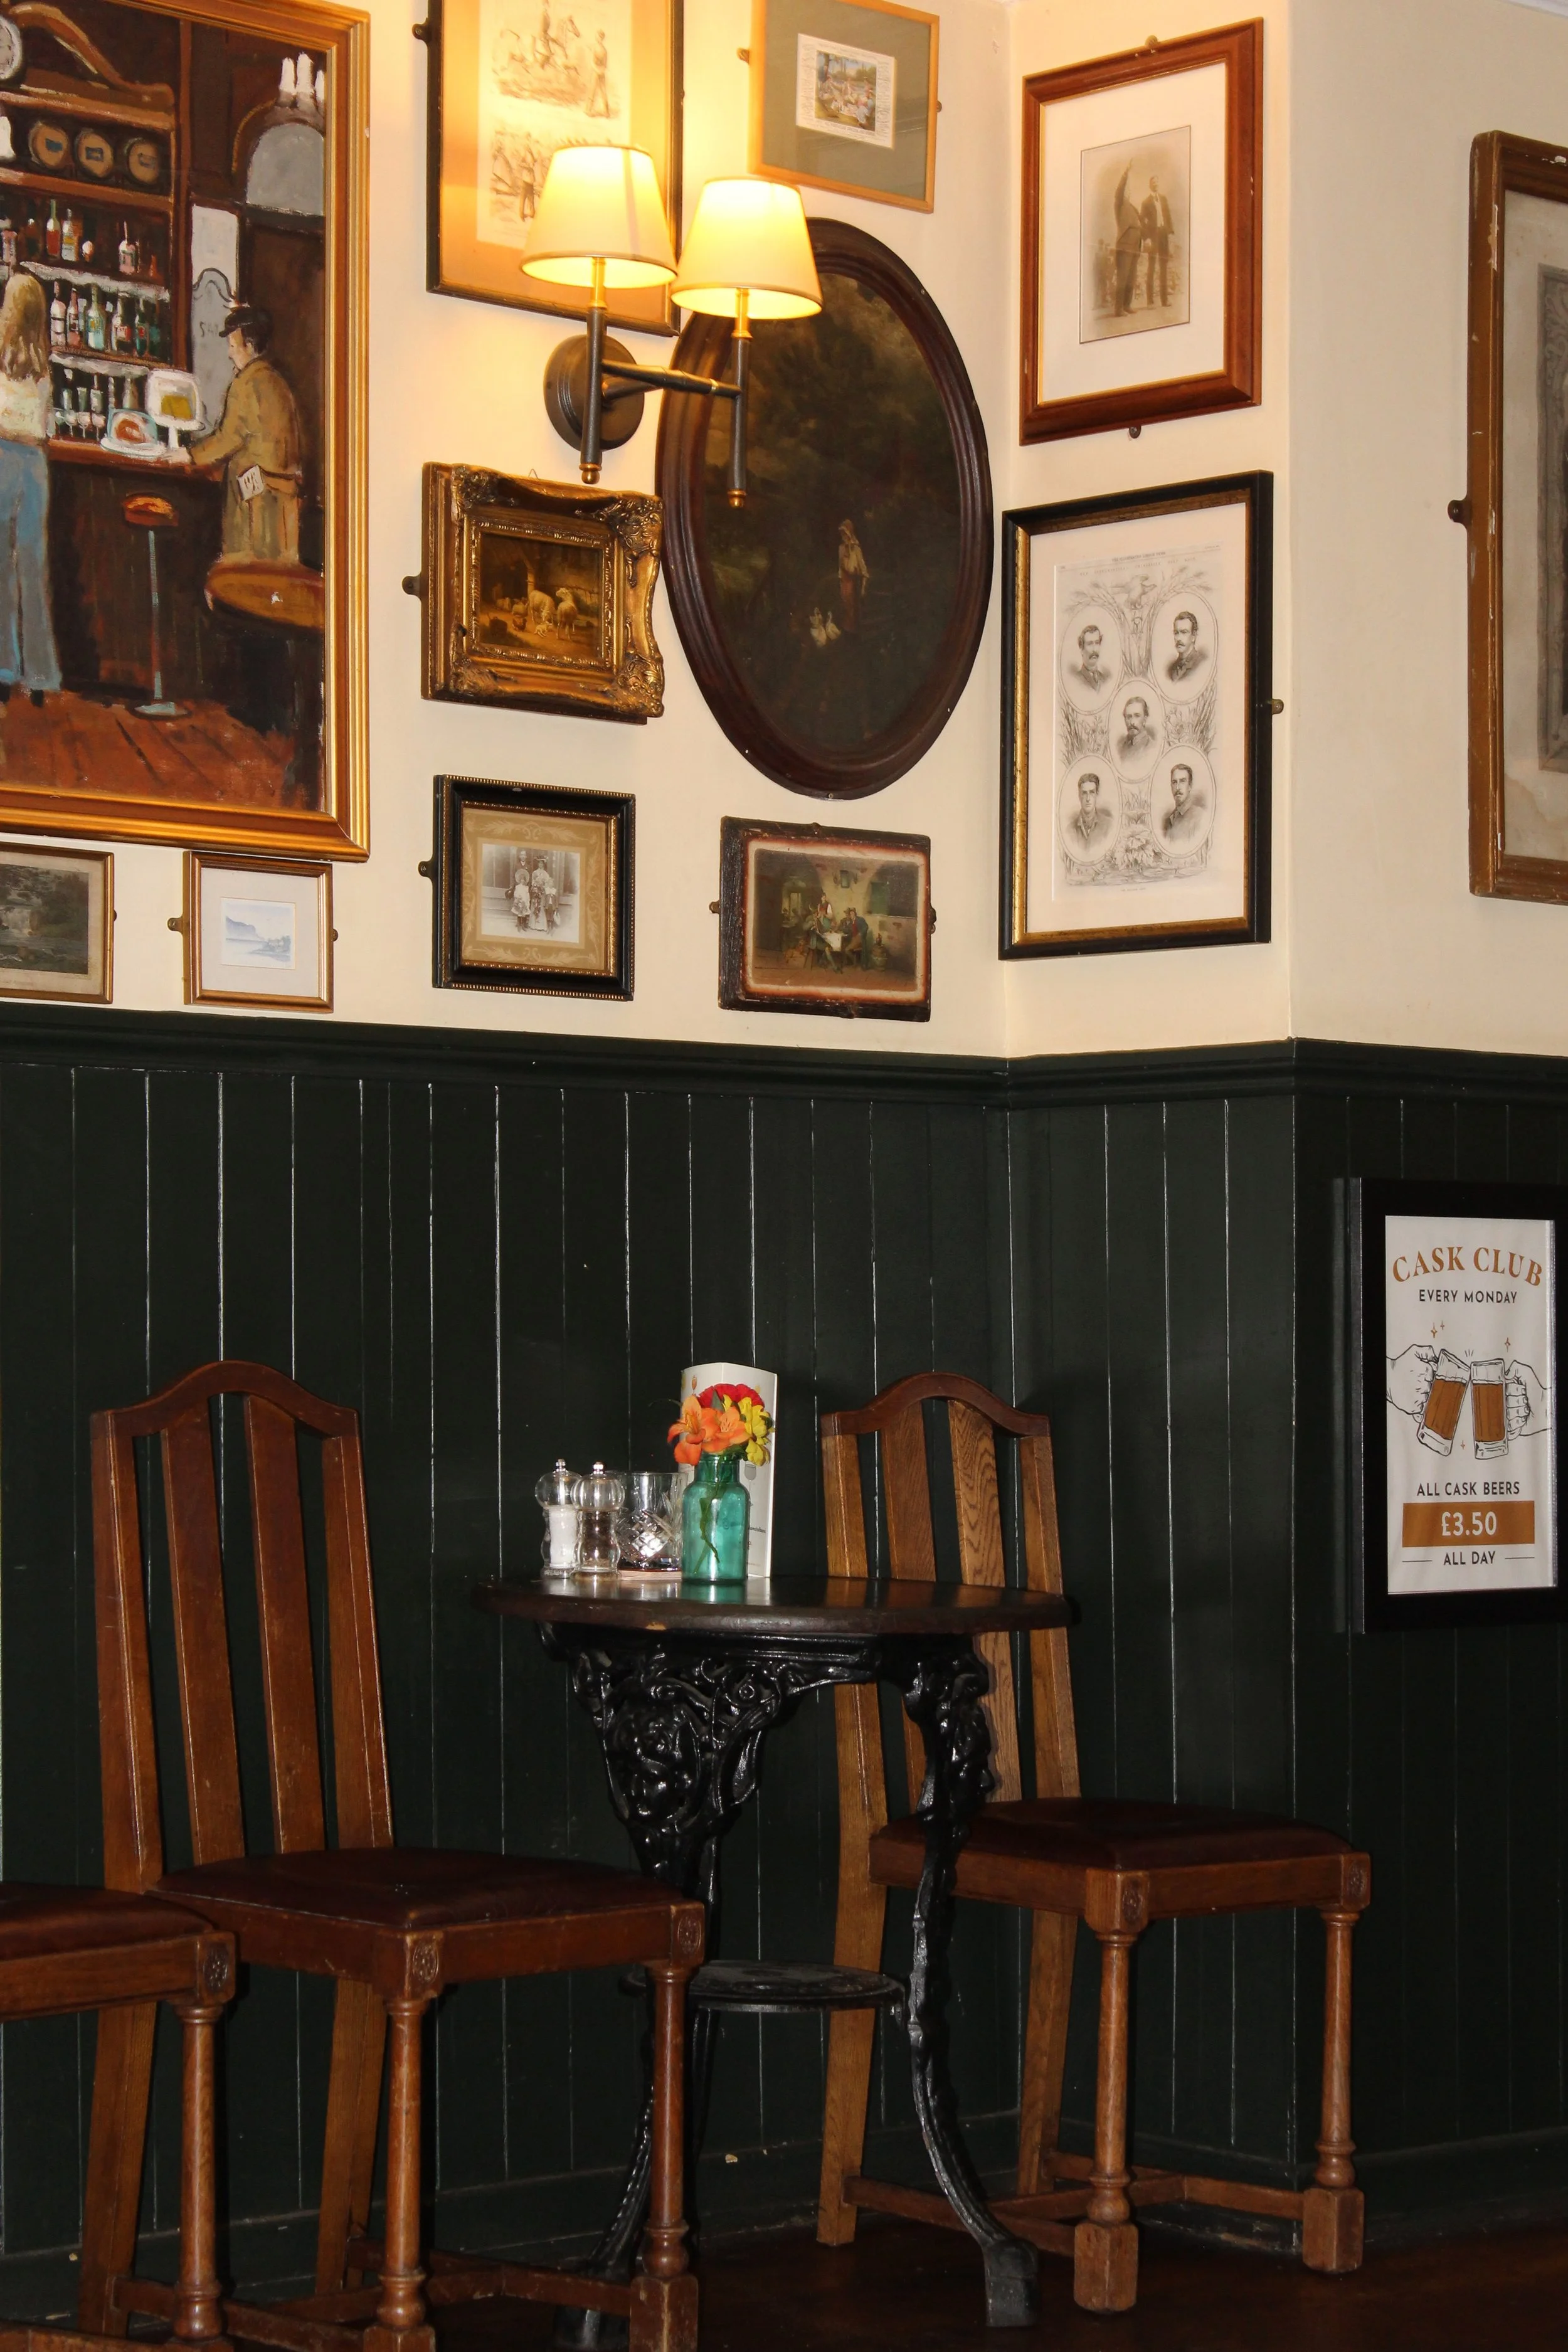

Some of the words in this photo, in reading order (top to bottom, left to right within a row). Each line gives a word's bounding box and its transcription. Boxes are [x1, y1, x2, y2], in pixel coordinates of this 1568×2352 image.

[1393, 1247, 1465, 1282] CASK
[1473, 1247, 1542, 1286] CLUB
[1419, 1289, 1458, 1303] EVERY
[1464, 1290, 1517, 1303] MONDAY
[1417, 1482, 1440, 1496] ALL
[1444, 1482, 1477, 1496] CASK
[1483, 1481, 1520, 1495] BEERS
[1441, 1511, 1497, 1536] £3.50
[1443, 1551, 1466, 1565] ALL
[1471, 1550, 1495, 1564] DAY
